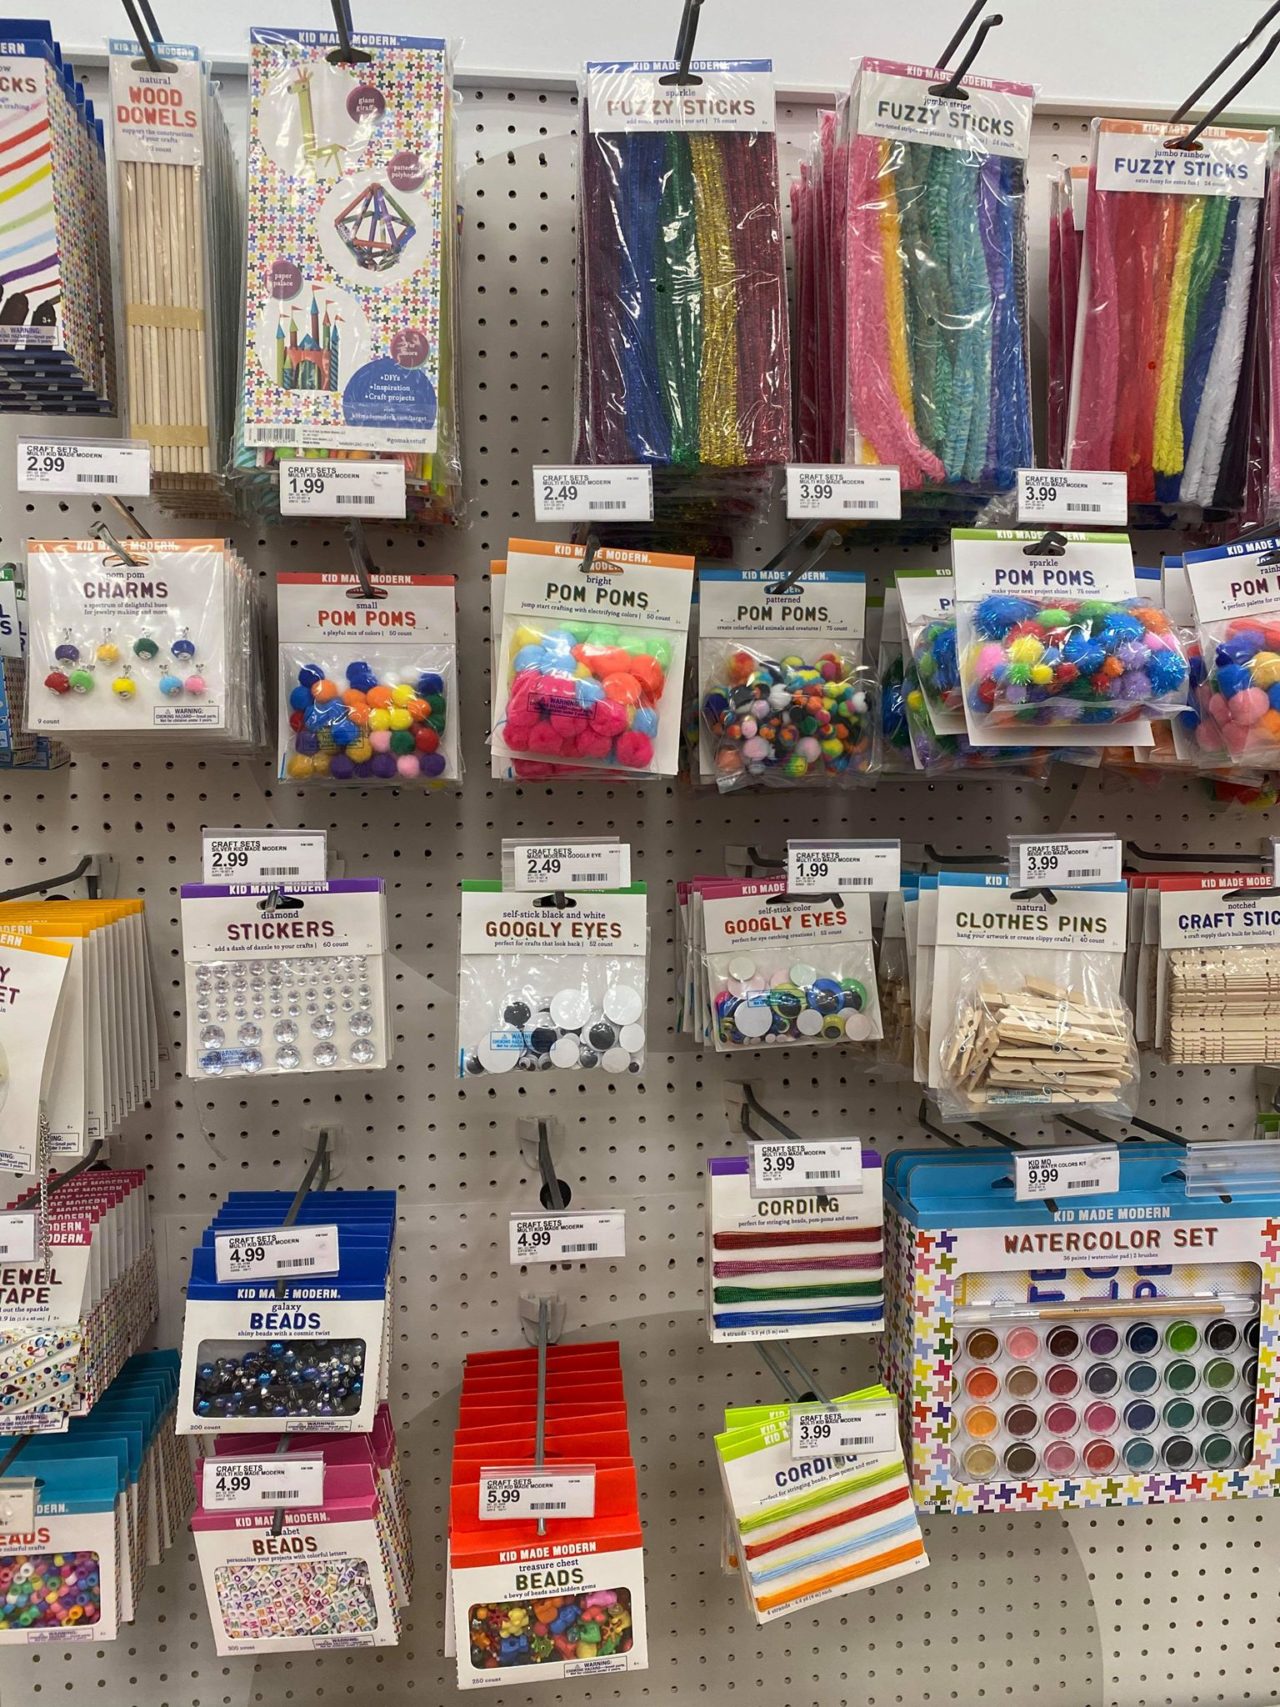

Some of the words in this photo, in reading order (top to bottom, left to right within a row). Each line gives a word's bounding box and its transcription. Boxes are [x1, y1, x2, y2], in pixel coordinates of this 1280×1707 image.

[299, 32, 316, 43] KID
[139, 77, 171, 85] natural
[129, 86, 182, 106] WOOD
[607, 101, 674, 116] FUZZY
[685, 101, 756, 115] STICKS
[923, 96, 946, 106] jumbo
[950, 101, 971, 111] stripe
[117, 105, 197, 128] DOWELS
[879, 101, 940, 125] FUZZY
[950, 112, 1014, 137] STICKS
[1155, 150, 1178, 158] jumbo
[1180, 151, 1210, 159] rainbow
[1114, 158, 1175, 175] FUZZY
[1184, 160, 1248, 179] STICKS
[373, 384, 410, 392] Inspiration
[388, 394, 415, 402] projects
[27, 457, 65, 472] 2.99
[289, 479, 324, 493] 1.99
[544, 486, 578, 500] 2.49
[800, 485, 832, 499] 3.99
[1026, 487, 1056, 501] 3.99
[996, 531, 1014, 539] KID
[1017, 531, 1042, 540] MADE
[555, 545, 572, 555] KID
[1227, 545, 1243, 555] KID
[1246, 540, 1273, 552] MADE
[1030, 559, 1058, 567] sparkle
[126, 572, 145, 580] pom
[322, 574, 337, 582] KID
[586, 575, 611, 586] bright
[742, 572, 756, 580] KID
[760, 572, 785, 580] MADE
[995, 569, 1034, 585] POM
[1044, 570, 1094, 586] POMS
[84, 582, 168, 598] CHARMS
[1231, 578, 1269, 598] POM
[547, 583, 586, 602] POM
[596, 588, 649, 608] POMS
[766, 596, 801, 605] patterned
[318, 610, 356, 626] POM
[366, 611, 416, 626] POMS
[588, 609, 620, 617] electrifying
[737, 606, 772, 621] POM
[781, 606, 828, 621] POMS
[212, 852, 248, 867] 2.99
[528, 859, 561, 874] 2.49
[1027, 856, 1058, 871] 3.99
[796, 863, 828, 877] 1.99
[229, 885, 247, 894] KID
[742, 884, 758, 895] KID
[760, 883, 785, 893] MADE
[1202, 879, 1216, 888] KID
[1219, 879, 1244, 887] MADE
[758, 906, 793, 915] self-stick
[794, 904, 811, 912] color
[1228, 901, 1256, 909] notched
[261, 911, 299, 919] diamond
[503, 910, 540, 919] self-stick
[542, 911, 564, 919] black
[566, 911, 581, 919] and
[583, 911, 606, 919] white
[1179, 912, 1235, 929] CRAFT
[486, 921, 562, 938] GOOGLY
[571, 922, 622, 938] EYES
[724, 916, 792, 935] GOOGLY
[801, 910, 848, 928] EYES
[956, 912, 1049, 931] CLOTHES
[1058, 916, 1107, 934] PINS
[228, 921, 334, 941] STICKERS
[763, 1157, 795, 1172] 3.99
[1029, 1169, 1058, 1184] 9.99
[1054, 1210, 1075, 1222] KID
[1079, 1208, 1115, 1221] MADE
[1118, 1207, 1170, 1220] MODERN
[517, 1221, 541, 1229] CRAFT
[257, 1235, 276, 1243] SETS
[517, 1232, 551, 1248] 4.99
[1004, 1229, 1161, 1253] WATERCOLOR
[1173, 1227, 1218, 1247] SET
[230, 1247, 265, 1263] 4.99
[238, 1289, 255, 1299] KID
[272, 1303, 301, 1312] galaxy
[250, 1313, 320, 1329] BEADS
[801, 1425, 831, 1440] 3.99
[216, 1477, 250, 1491] 4.99
[487, 1490, 520, 1503] 5.99
[236, 1517, 251, 1527] KID
[253, 1536, 317, 1555] BEADS
[500, 1551, 517, 1562] KID
[520, 1547, 550, 1560] MADE
[553, 1541, 596, 1556] MODERN
[519, 1562, 554, 1572] treasure
[556, 1559, 579, 1568] chest
[516, 1568, 583, 1591] BEADS
[561, 1585, 580, 1593] hidden
